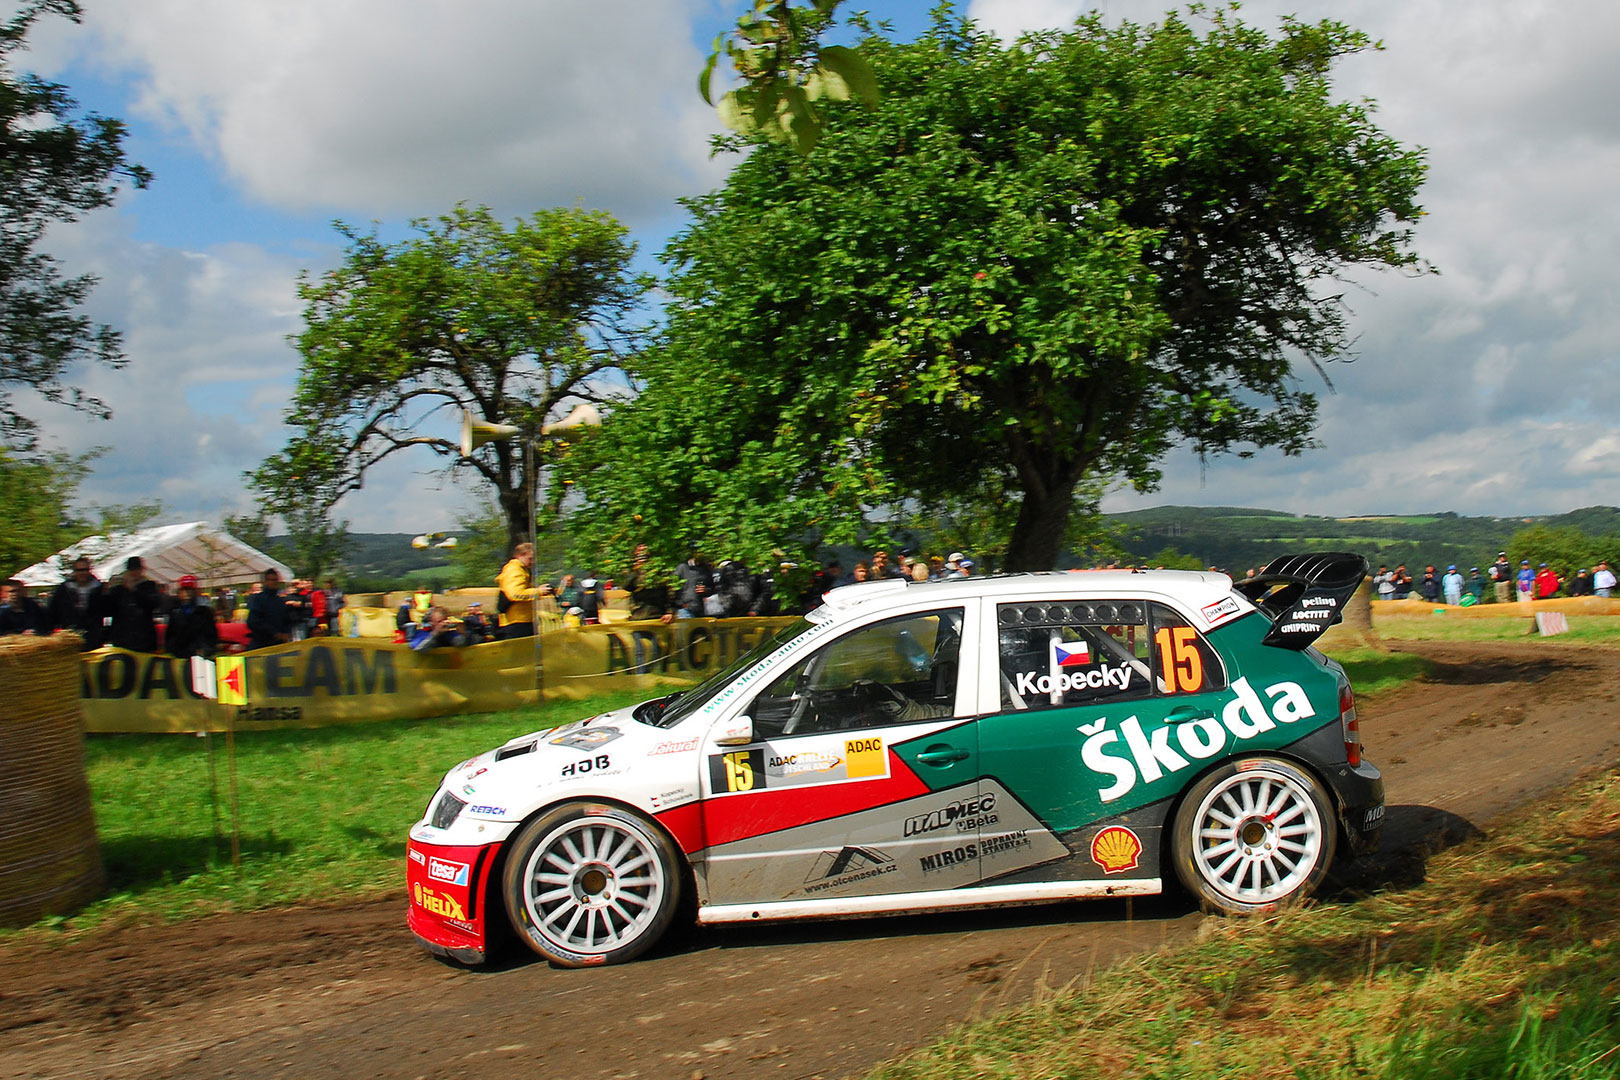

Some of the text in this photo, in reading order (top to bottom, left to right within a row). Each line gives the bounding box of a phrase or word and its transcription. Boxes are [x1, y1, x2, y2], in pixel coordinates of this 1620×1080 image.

[1206, 602, 1235, 618] CHAMPION
[1292, 610, 1331, 620] LOCTITE
[703, 619, 834, 714] www.skoda-auto.com
[1155, 626, 1204, 694] 15
[1016, 661, 1133, 697] Kopecký
[847, 739, 882, 754] ADAC
[1077, 675, 1317, 802] Škoda
[722, 751, 754, 792] 15
[768, 755, 797, 768] ADAC
[967, 813, 999, 831] Beta
[431, 860, 457, 880] tesa
[919, 843, 979, 872] MIROS
[803, 863, 898, 894] www.otcenasek.cz
[423, 892, 467, 921] HELIX
